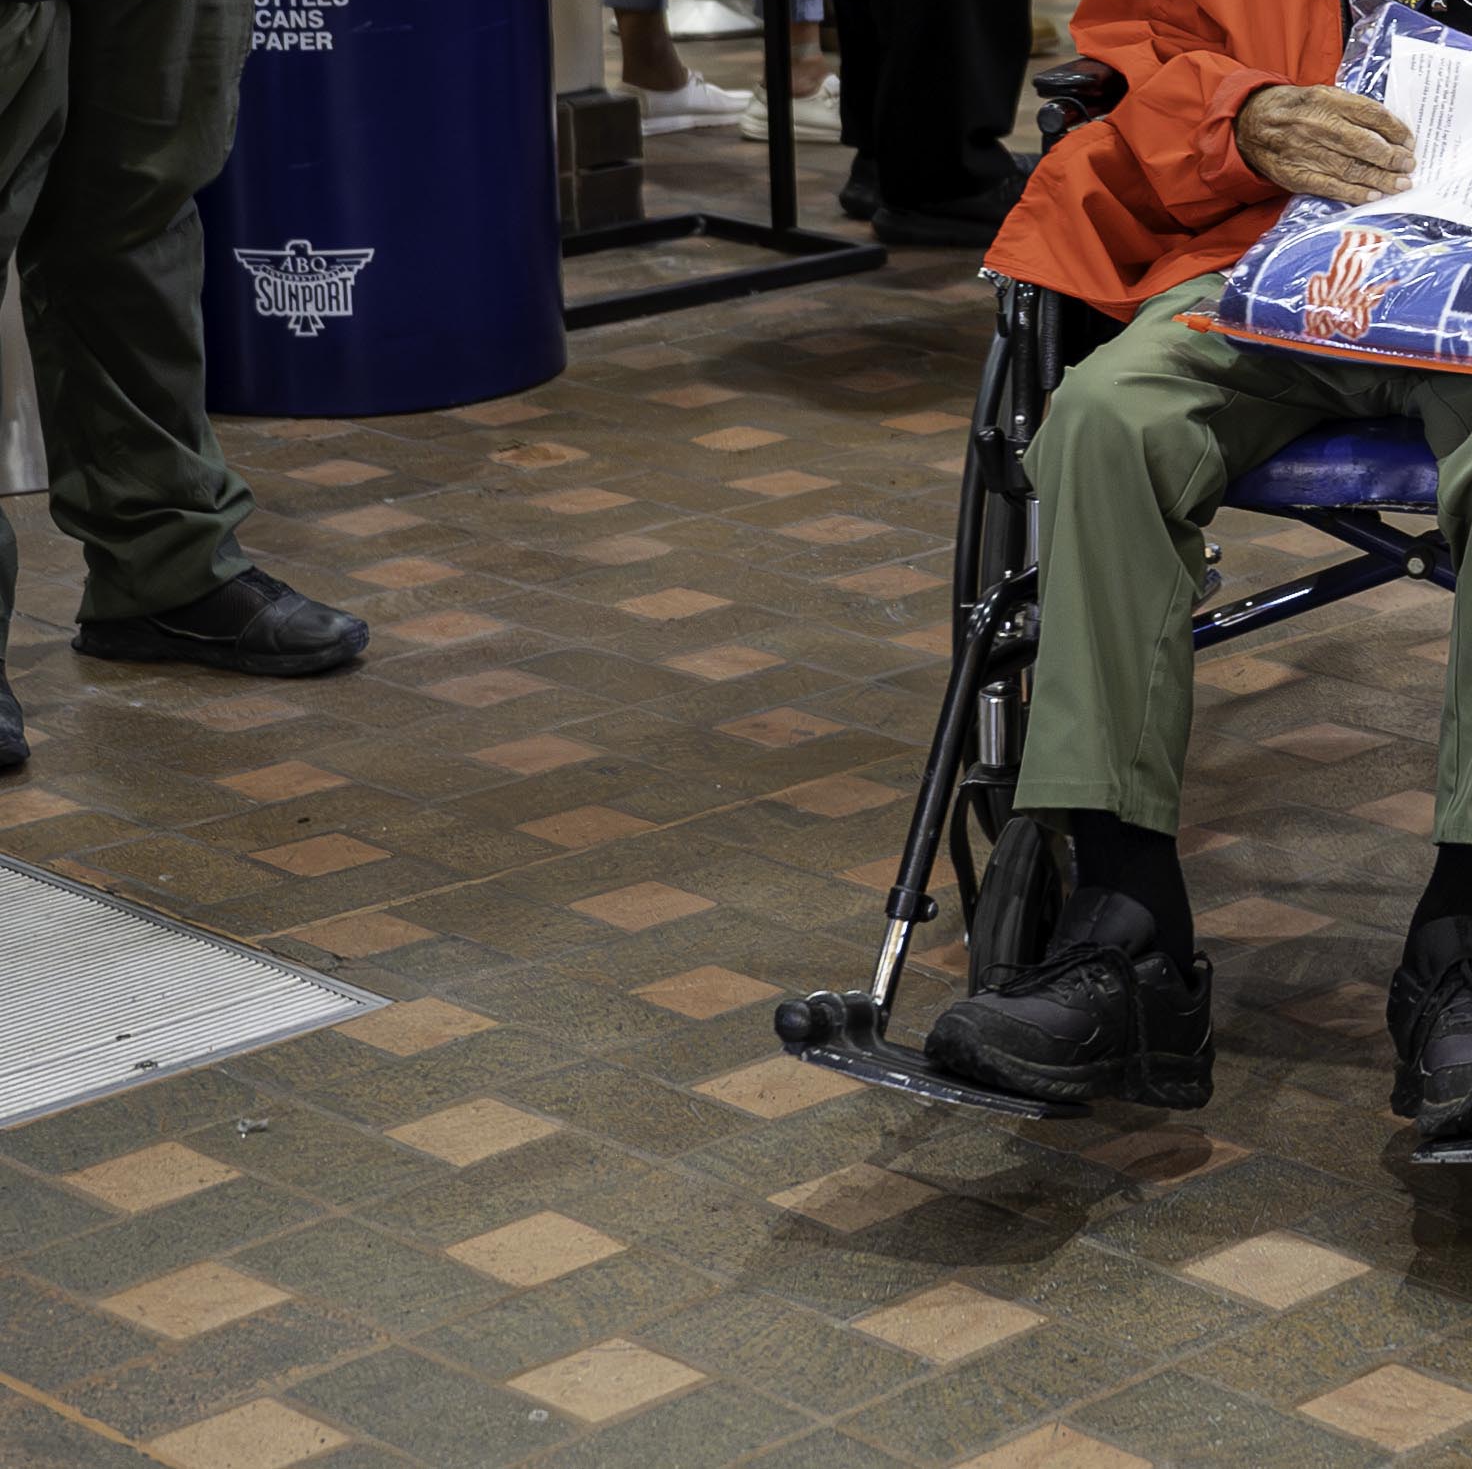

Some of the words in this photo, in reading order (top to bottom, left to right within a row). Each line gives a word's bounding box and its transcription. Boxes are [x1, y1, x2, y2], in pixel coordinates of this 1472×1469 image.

[255, 10, 324, 28] CANS
[252, 31, 333, 51] PAPER
[280, 256, 328, 273] ABQ
[258, 274, 353, 314] SUNPORT
